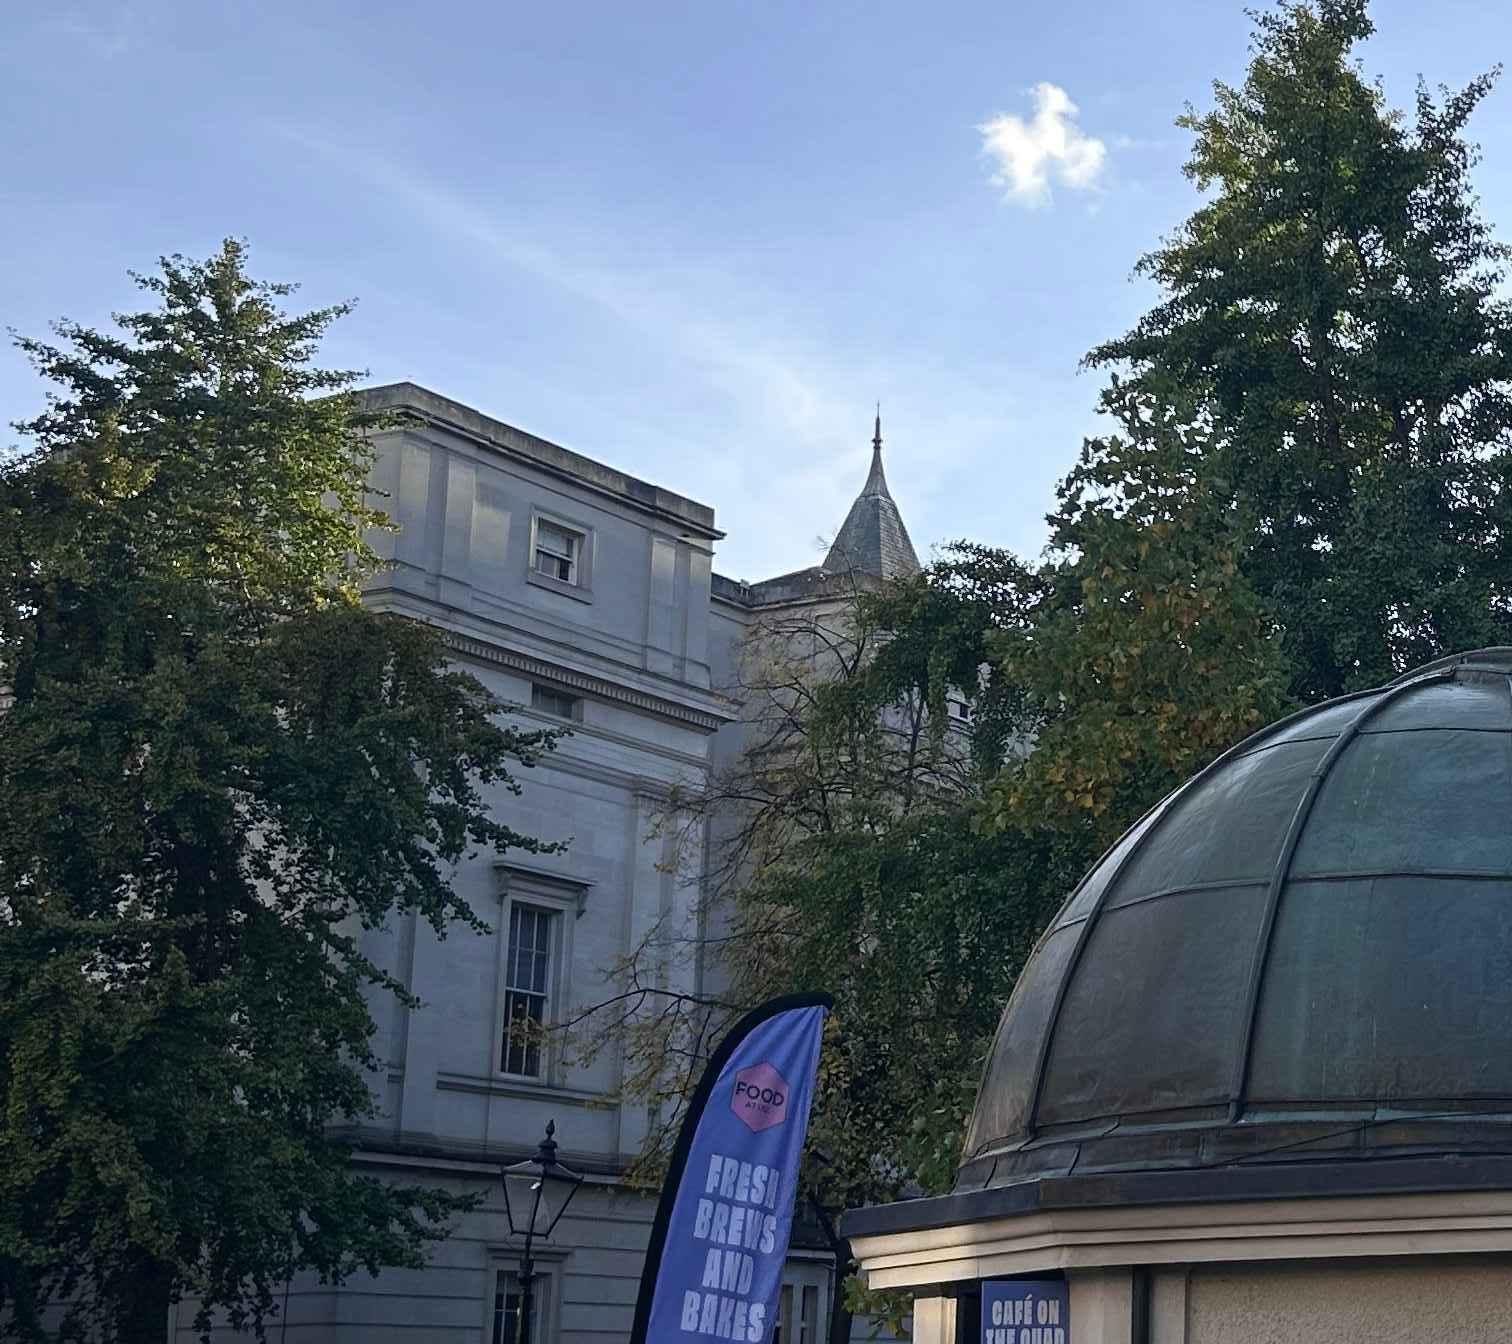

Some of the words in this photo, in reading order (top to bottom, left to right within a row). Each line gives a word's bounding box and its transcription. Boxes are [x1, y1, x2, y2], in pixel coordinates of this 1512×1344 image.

[736, 1081, 785, 1106] FOOD
[705, 1154, 780, 1209] FRESH
[693, 1198, 777, 1254] BREWS
[702, 1247, 754, 1295] AND
[680, 1289, 767, 1343] BAKES
[992, 1293, 1033, 1326] CAFÉ
[1037, 1299, 1060, 1325] ON
